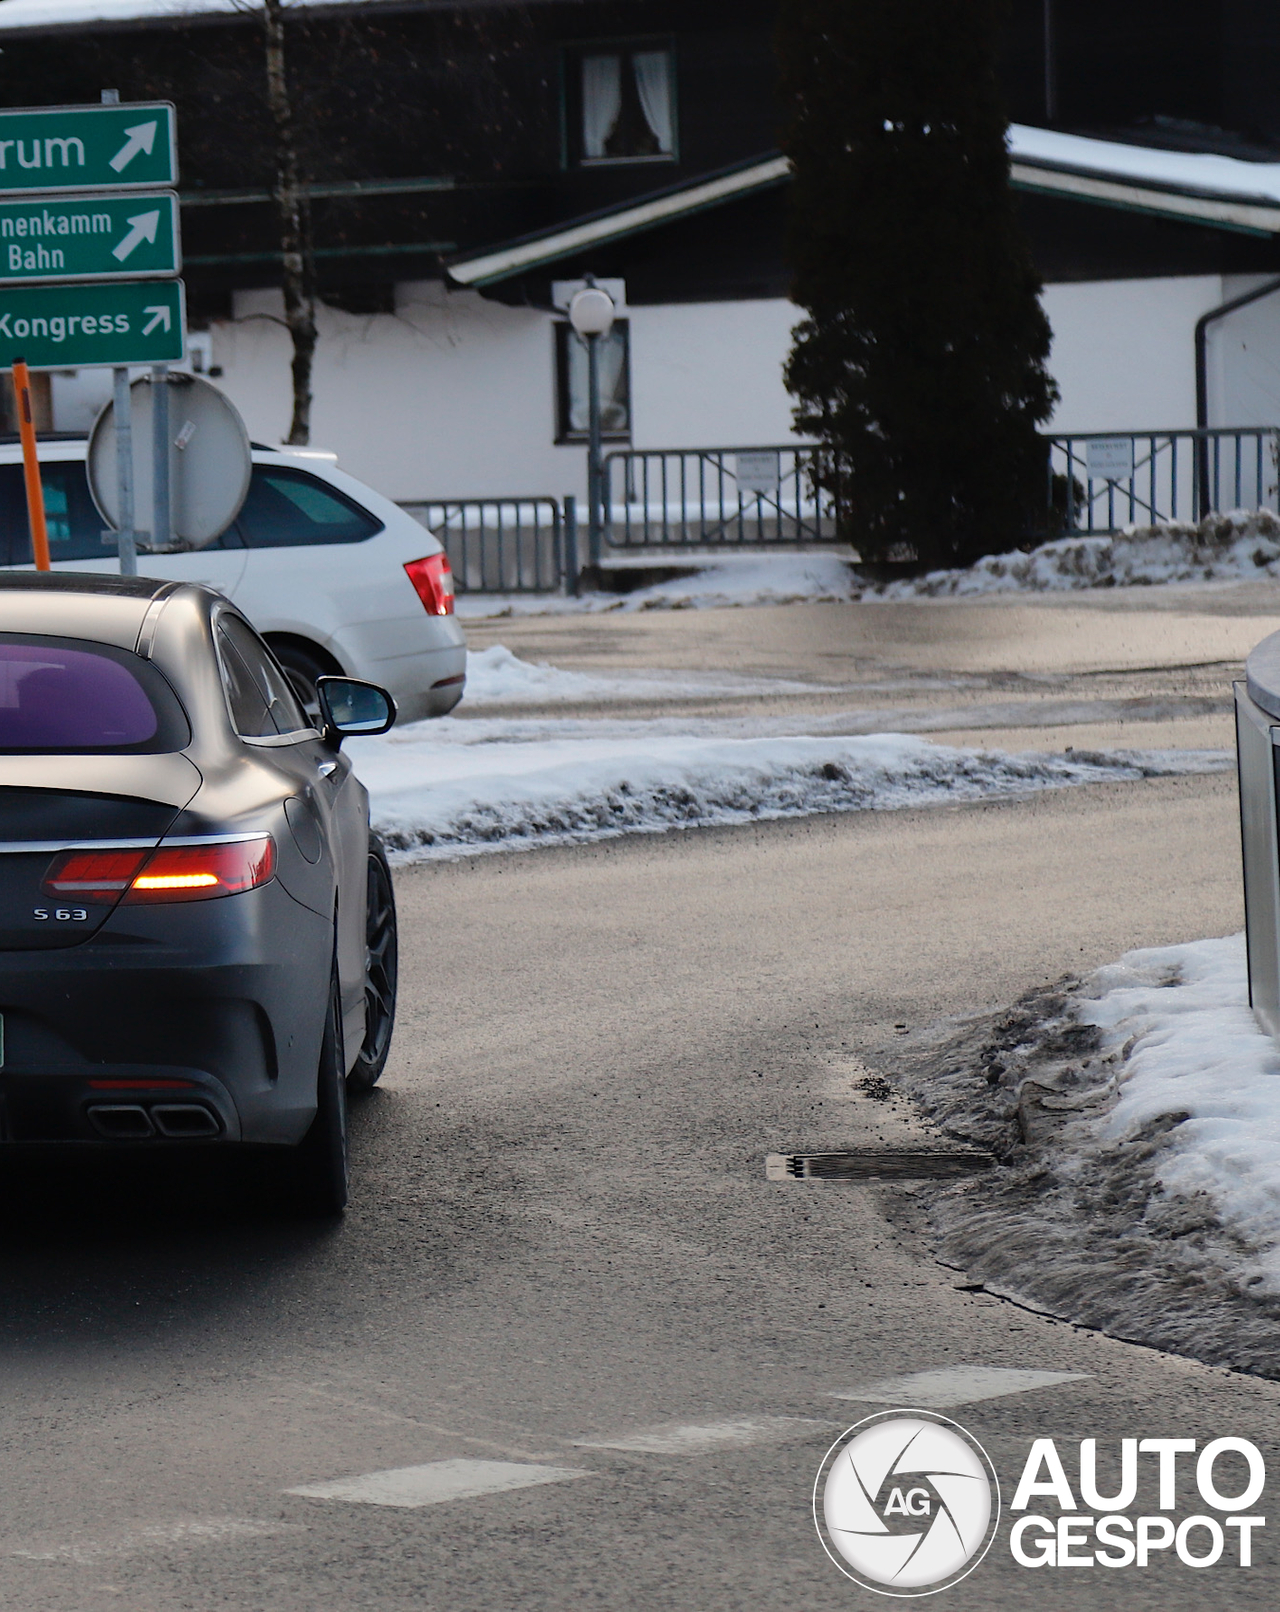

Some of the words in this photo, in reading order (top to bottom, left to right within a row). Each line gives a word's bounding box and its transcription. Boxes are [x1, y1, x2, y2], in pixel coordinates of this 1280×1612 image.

[8, 244, 65, 271] Bahn
[33, 908, 49, 921] S
[54, 908, 88, 921] 63
